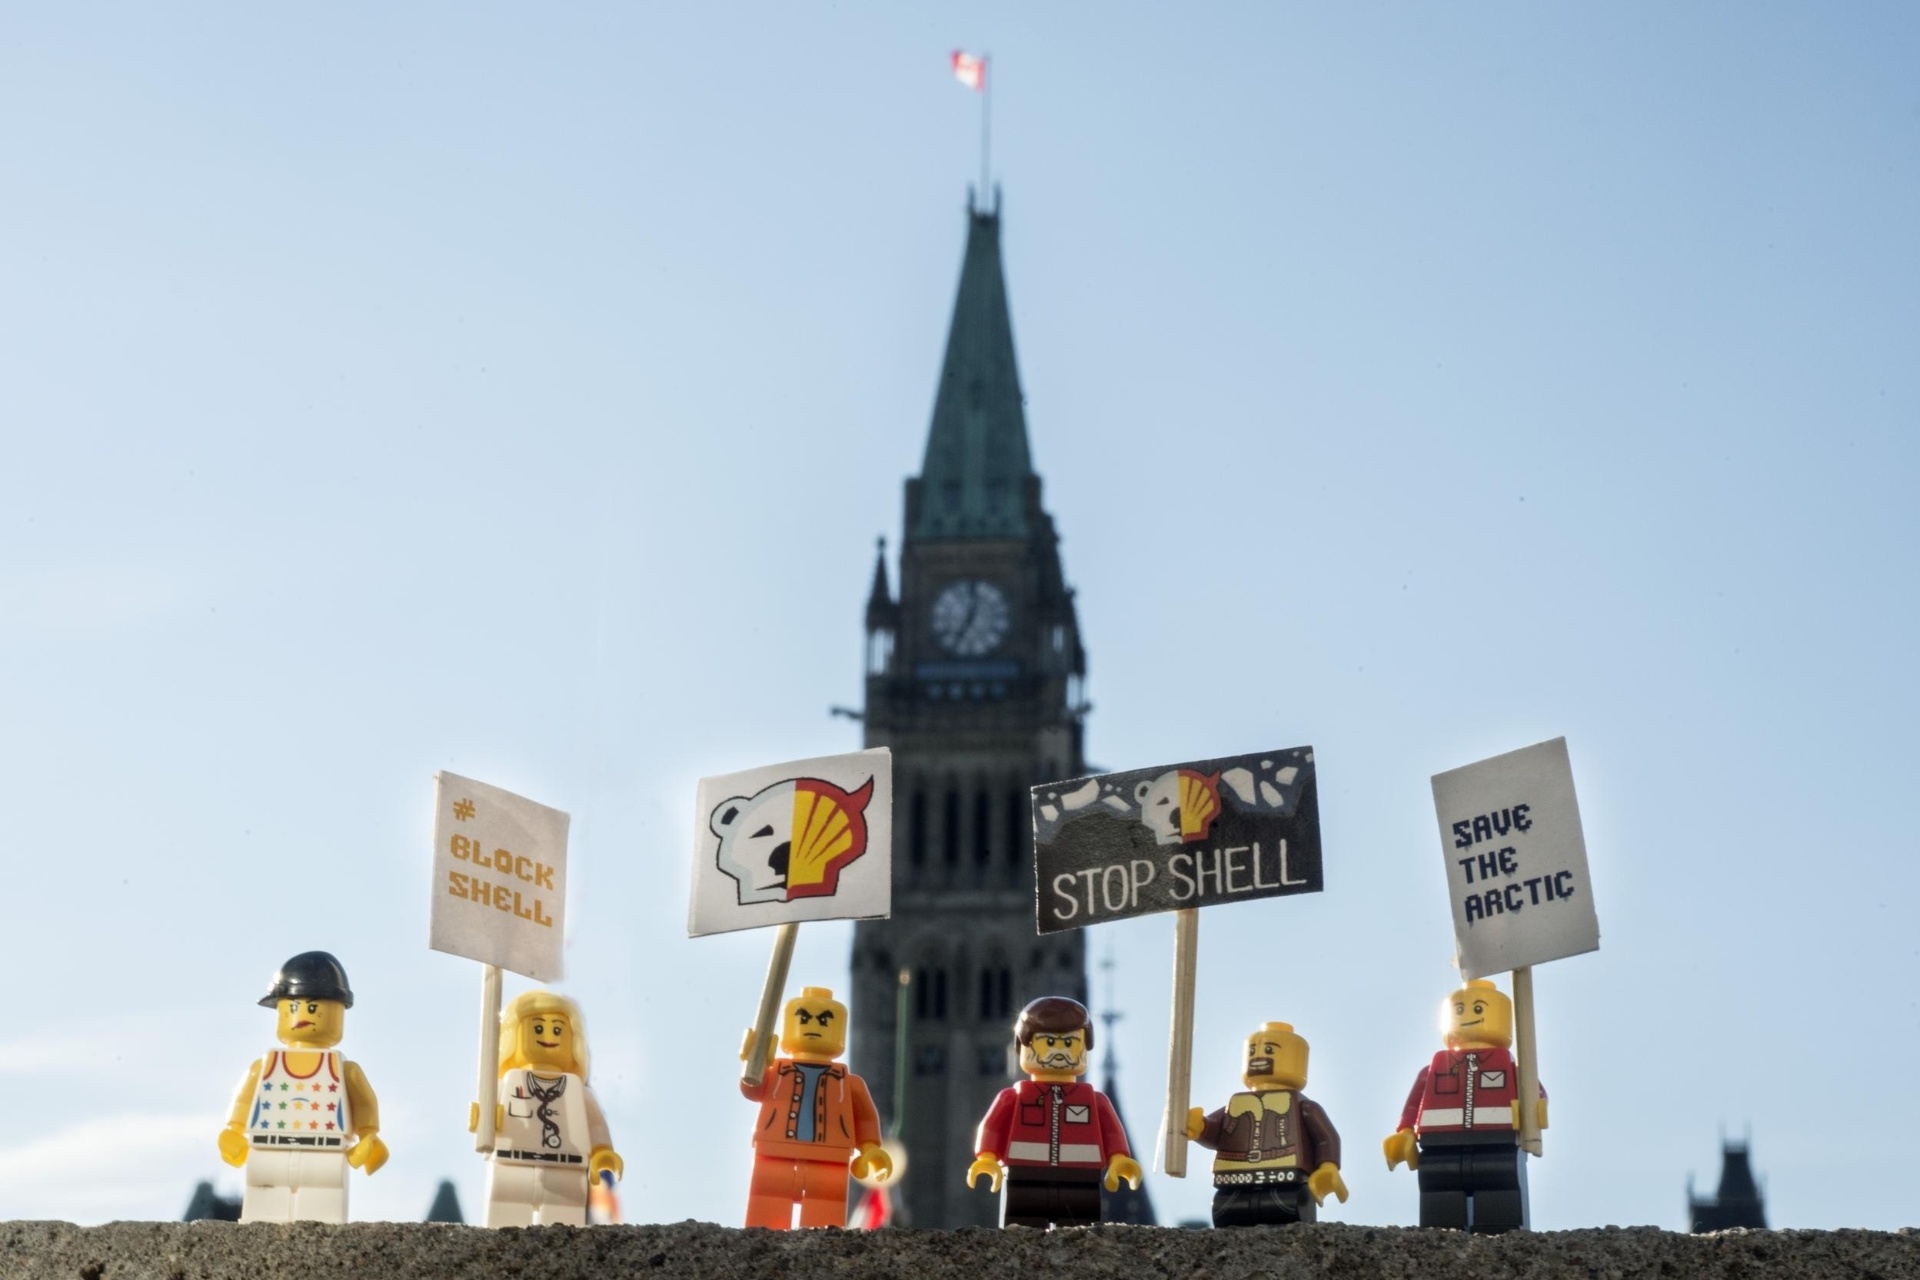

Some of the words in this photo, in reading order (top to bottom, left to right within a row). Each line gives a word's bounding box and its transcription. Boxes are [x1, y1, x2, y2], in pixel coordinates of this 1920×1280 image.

[1452, 803, 1533, 850] SAVE
[451, 834, 554, 889] BLOCK
[1052, 861, 1155, 920] STOP
[1169, 839, 1307, 898] SHELL
[1458, 846, 1518, 884] THE
[449, 871, 552, 927] SHELL
[1465, 871, 1575, 925] ARCTIC
